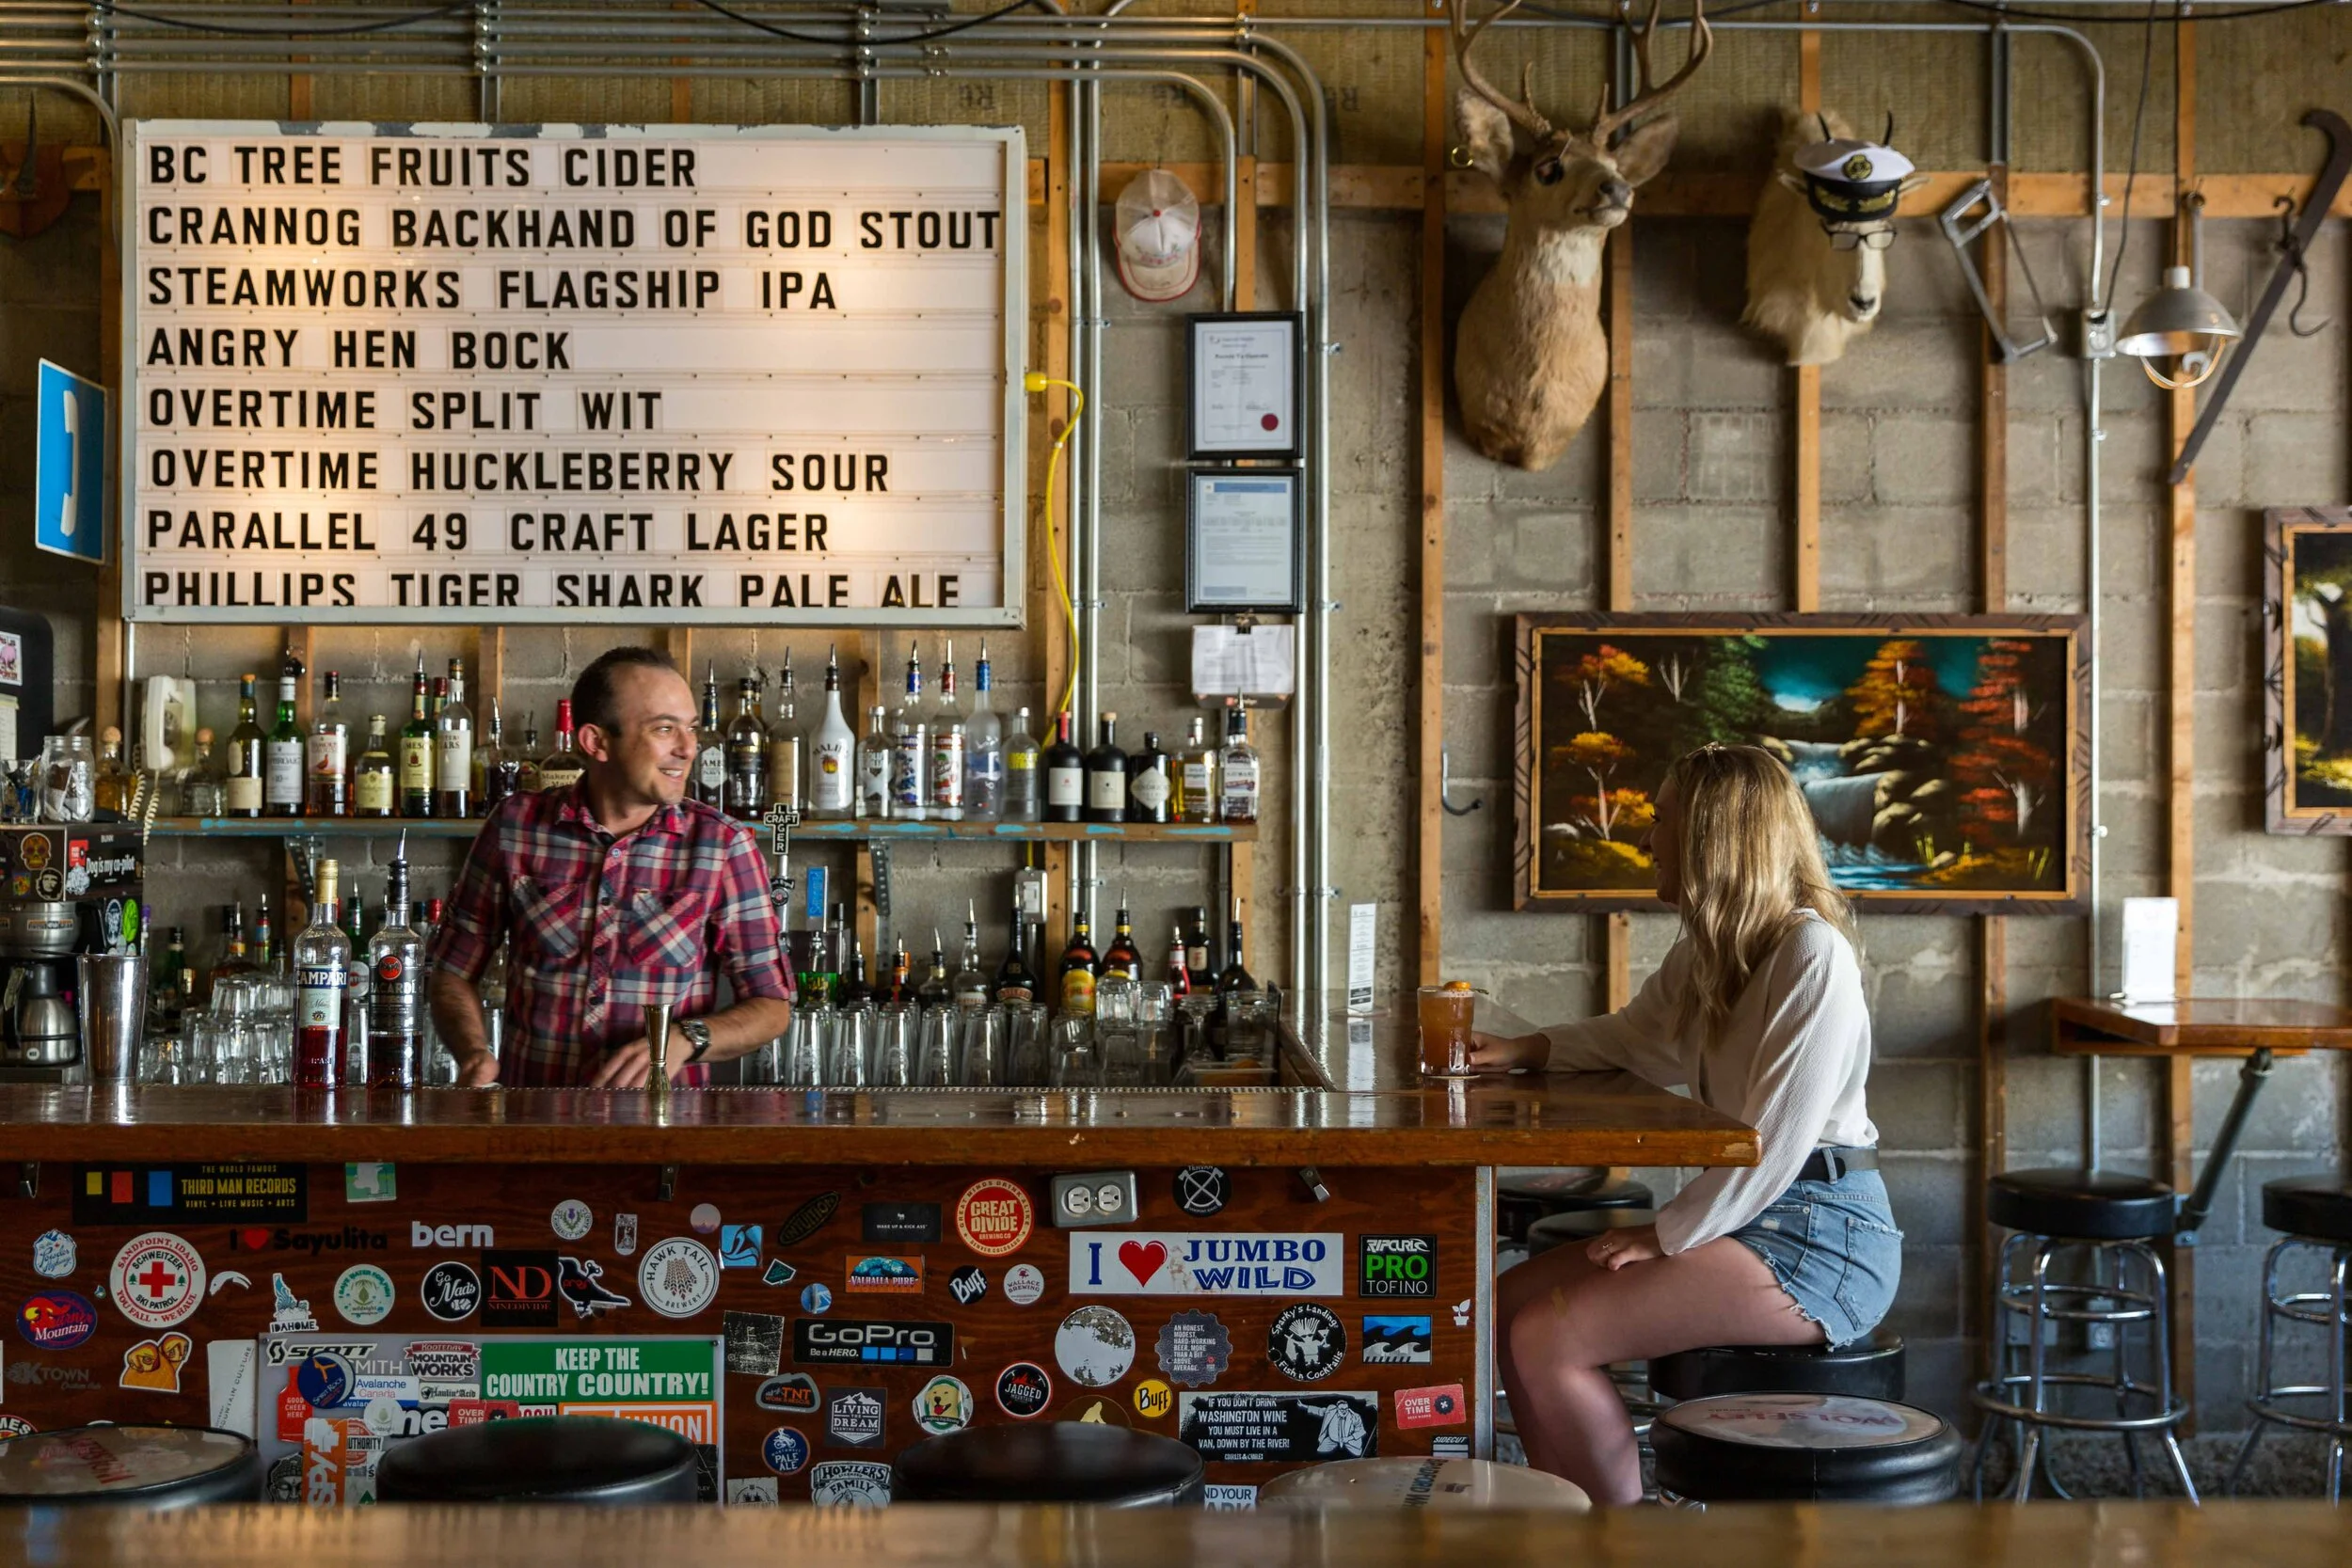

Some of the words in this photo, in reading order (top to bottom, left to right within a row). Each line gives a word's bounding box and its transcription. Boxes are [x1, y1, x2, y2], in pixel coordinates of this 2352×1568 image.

[151, 146, 206, 182] BC
[234, 147, 340, 183] TREE
[373, 148, 529, 186] FRUITS
[565, 149, 694, 186] CIDER
[150, 207, 358, 245] CRANNOG
[393, 210, 633, 247] BACKHAND
[665, 210, 715, 247] OF
[747, 212, 830, 247] GOD
[862, 211, 1001, 248] STOUT
[150, 268, 458, 308] STEAMWORKS
[501, 270, 718, 309] FLAGSHIP
[763, 272, 835, 309] IPA
[147, 328, 297, 366] ANGRY
[335, 331, 415, 368] HEN
[453, 332, 569, 369] BOCK
[151, 389, 374, 428] OVERTIME
[413, 391, 540, 430] SPLIT
[581, 392, 660, 429] WIT
[152, 450, 376, 489] OVERTIME
[413, 452, 733, 490] HUCKLEBERRY
[773, 455, 887, 491] SOUR
[149, 511, 374, 549] PARALLEL
[413, 514, 467, 550] 49
[512, 514, 652, 550] CRAFT
[688, 514, 826, 550] LAGER
[146, 572, 354, 606] PHILLIPS
[391, 574, 518, 607] TIGER
[558, 575, 703, 608] SHARK
[741, 575, 848, 608] PALE
[882, 575, 958, 608] ALE
[766, 815, 798, 823] CRAFT
[87, 857, 98, 878] Dog
[98, 856, 103, 873] is
[104, 859, 113, 876] my
[114, 854, 135, 876] co-pilot
[202, 1165, 215, 1174] THE
[219, 1165, 244, 1174] WORLD
[247, 1164, 278, 1173] FAMOUS
[181, 1179, 215, 1196] THIRD
[216, 1178, 243, 1196] MAN
[246, 1178, 296, 1195] RECORDS
[185, 1199, 207, 1209] VINYL
[219, 1199, 236, 1209] LIVE
[240, 1198, 264, 1208] MUSIC
[276, 1198, 295, 1208] ARTS
[970, 1199, 1018, 1216] GREAT
[970, 1216, 1019, 1233] DIVIDE
[230, 1228, 238, 1250] I
[273, 1226, 388, 1257] Sayulita
[411, 1221, 494, 1247] bern
[132, 1250, 183, 1271] SCHWEITZER
[174, 1243, 199, 1272] IDAHO
[646, 1245, 676, 1280] HAWK
[683, 1245, 708, 1272] TAIL
[1089, 1242, 1103, 1285] I
[1183, 1239, 1327, 1262] JUMBO
[1366, 1254, 1428, 1279] PRO
[435, 1271, 453, 1287] Go
[486, 1265, 553, 1300] ND
[850, 1275, 889, 1286] VALHALLA
[892, 1275, 915, 1286] PURE
[1193, 1265, 1317, 1291] WILD
[429, 1278, 477, 1307] Nads
[1008, 1285, 1040, 1293] BREWING
[1366, 1280, 1429, 1294] TOFINO
[117, 1289, 131, 1308] YOU
[128, 1308, 151, 1323] FALL
[160, 1312, 178, 1323] WE
[176, 1293, 198, 1316] HAUL
[135, 1293, 149, 1308] SKI
[149, 1295, 178, 1310] PATROL
[665, 1293, 702, 1308] BREWERY
[1271, 1305, 1304, 1335] Sparky's
[1306, 1304, 1338, 1328] Landing
[34, 1322, 89, 1340] Mountain
[807, 1323, 934, 1346] GoPro
[1183, 1324, 1205, 1333] HONEST,
[413, 1354, 471, 1363] MOUNTAIN
[555, 1347, 601, 1370] KEEP
[605, 1347, 640, 1370] THE
[809, 1348, 821, 1357] Be
[828, 1348, 859, 1357] HERO.
[349, 1360, 403, 1375] MITH
[411, 1363, 474, 1376] WORKS
[1278, 1360, 1297, 1378] Fish
[1306, 1349, 1343, 1380] Cocktails
[356, 1378, 406, 1389] Avalanche
[486, 1373, 568, 1398] COUNTRY
[577, 1371, 709, 1396] COUNTRY!
[1004, 1382, 1042, 1400] JAGGED
[358, 1389, 396, 1399] Canada
[781, 1386, 812, 1401] TNT
[834, 1404, 879, 1415] LIVING
[1208, 1397, 1215, 1407] IF
[1217, 1397, 1232, 1407] YOU
[1232, 1397, 1253, 1407] DON'T
[1255, 1397, 1278, 1407] DRINK
[1405, 1397, 1431, 1407] OVER
[1405, 1405, 1431, 1415] TIME
[457, 1408, 485, 1417] OVER
[457, 1416, 485, 1424] TIME
[1198, 1410, 1261, 1423] WASHINGTON
[1263, 1410, 1288, 1423] WINE
[834, 1418, 879, 1428] DREAM
[1208, 1425, 1223, 1435] YOU
[1224, 1425, 1245, 1435] MUST
[1246, 1425, 1262, 1435] LIVE
[1263, 1425, 1270, 1435] IN
[1272, 1425, 1278, 1435] A
[346, 1436, 382, 1449] UTHORITY
[1198, 1438, 1216, 1449] VAN,
[1216, 1438, 1238, 1449] DOWN
[1239, 1438, 1250, 1449] BY
[1251, 1438, 1266, 1449] THE
[1267, 1438, 1290, 1449] RIVER!
[774, 1452, 800, 1465] PALE
[779, 1461, 799, 1472] ALE
[307, 1450, 338, 1506] SPY
[821, 1465, 886, 1481] HOWLERS
[829, 1480, 875, 1496] FAMILY
[1220, 1487, 1252, 1500] YOUR
